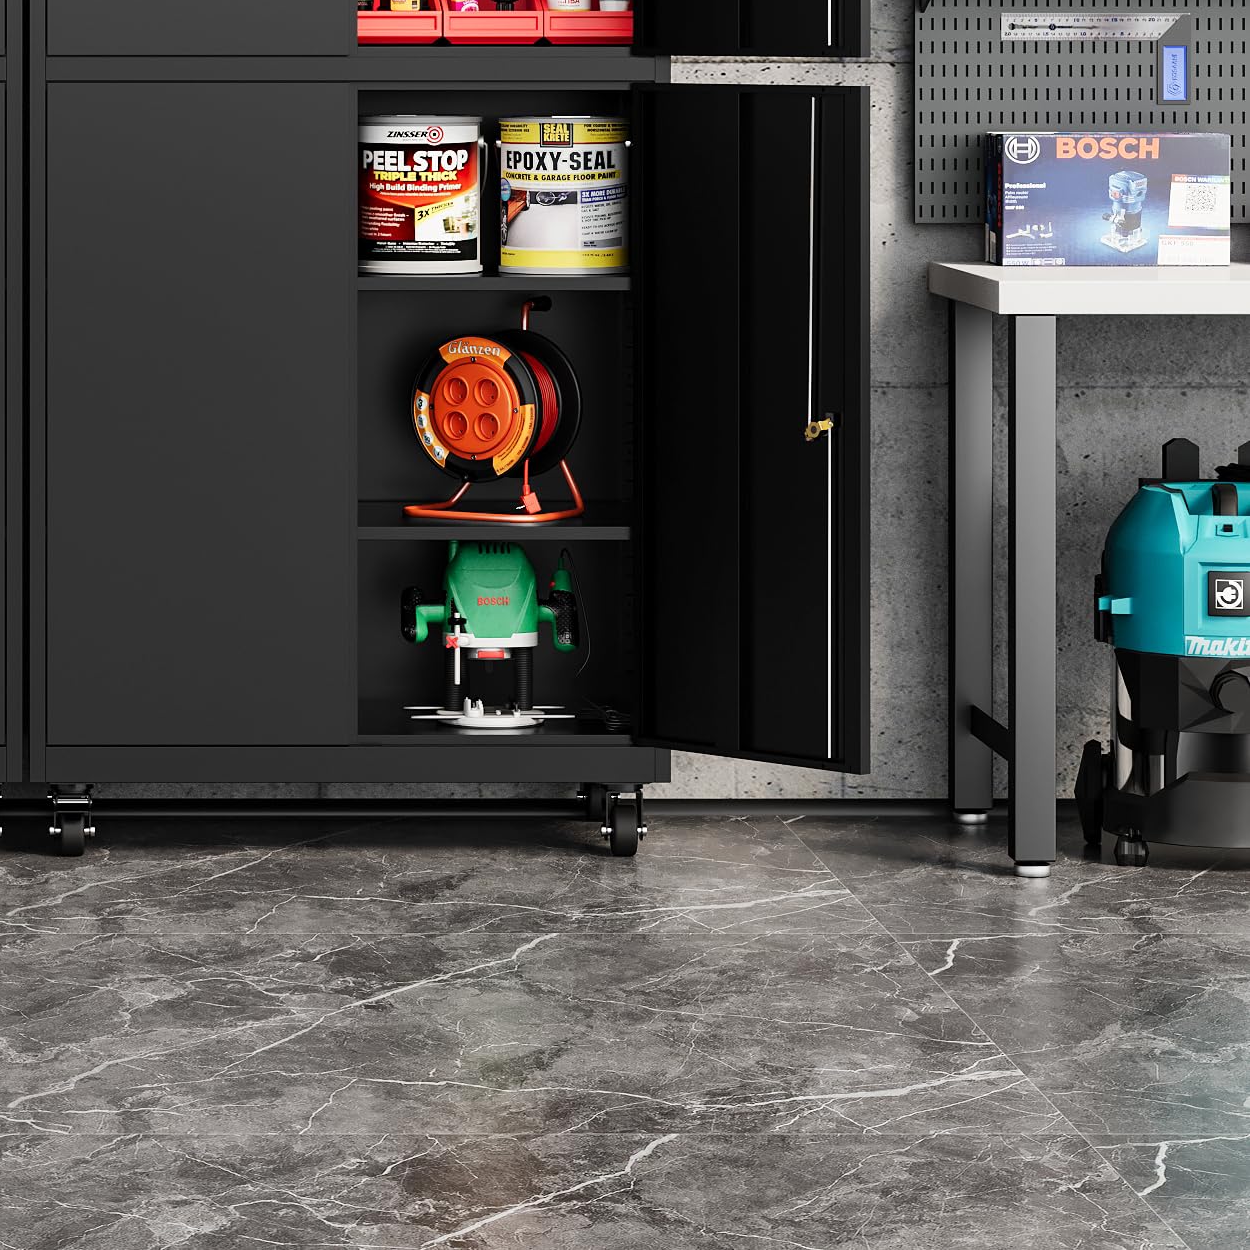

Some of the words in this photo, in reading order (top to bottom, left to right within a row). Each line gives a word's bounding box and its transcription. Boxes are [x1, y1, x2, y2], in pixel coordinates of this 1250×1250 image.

[386, 130, 428, 138] ZINSSER
[543, 124, 570, 134] SEAL
[543, 134, 570, 142] KRETE
[1056, 137, 1160, 160] BOSCH
[363, 150, 412, 172] PEEL
[413, 150, 468, 172] STOP
[506, 150, 616, 170] EPOXY-SEAL
[373, 171, 417, 182] TRIPLE
[419, 171, 458, 182] THICK
[506, 172, 531, 181] CONCRETE
[370, 183, 385, 191] High
[407, 184, 438, 192] Binding
[448, 340, 501, 357] Glänzen
[477, 596, 510, 606] BOSCH
